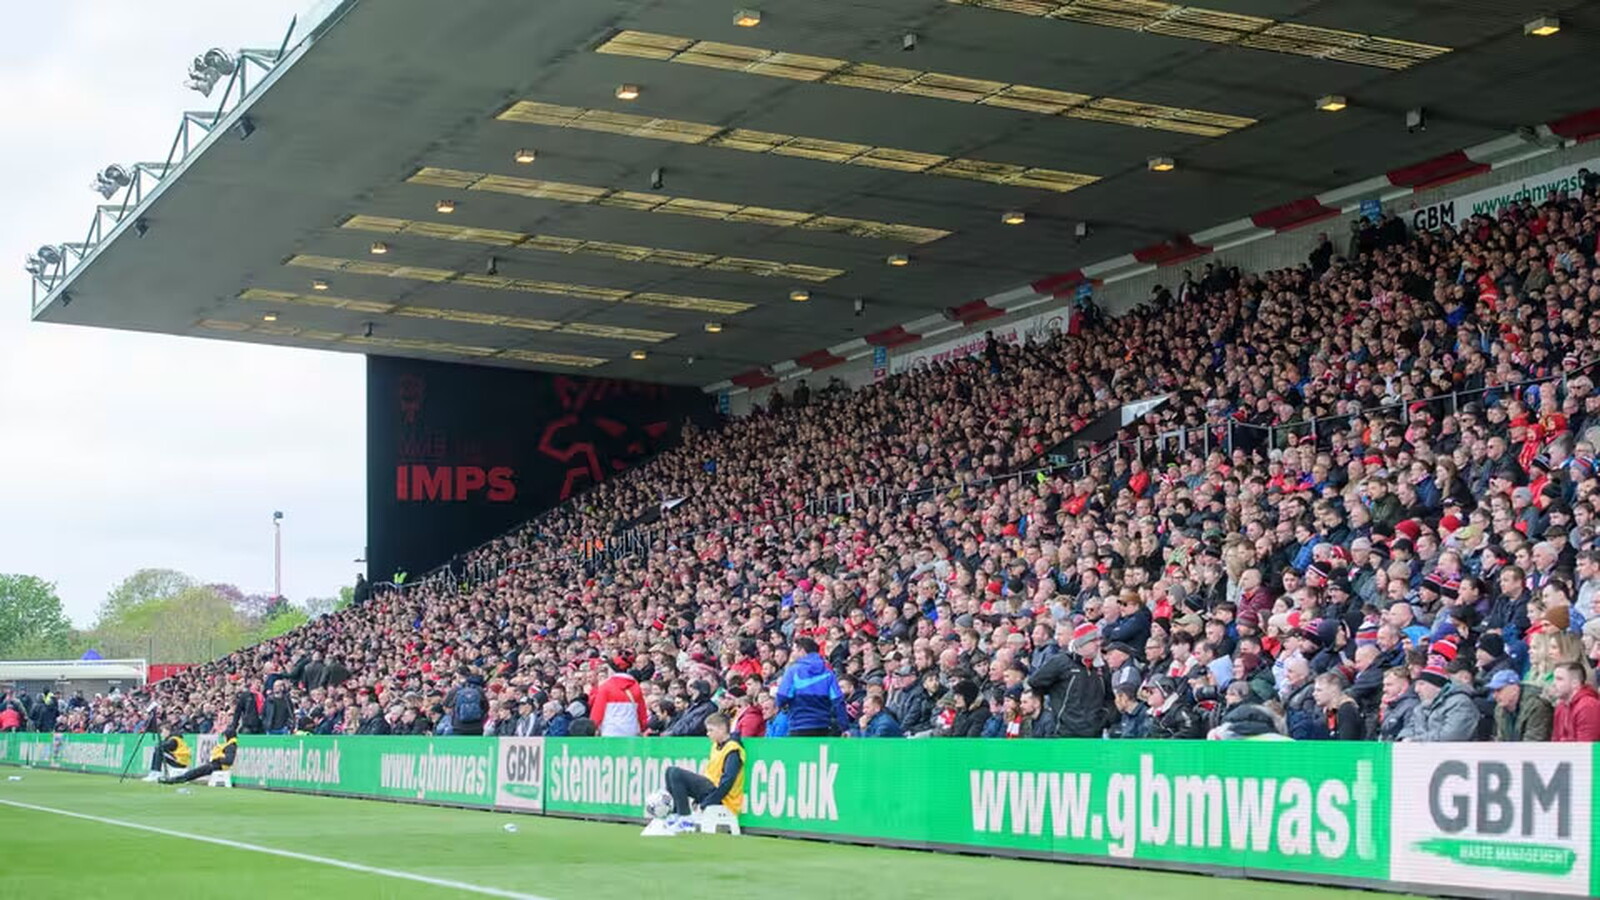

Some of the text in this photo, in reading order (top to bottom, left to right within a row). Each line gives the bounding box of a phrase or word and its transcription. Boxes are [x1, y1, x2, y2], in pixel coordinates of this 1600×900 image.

[1414, 201, 1454, 231] GBM
[397, 466, 516, 501] IMPS
[506, 745, 540, 782] GBM
[969, 754, 1378, 861] www.gbmwast
[1429, 760, 1573, 839] GBM
[1460, 844, 1568, 864] WASTE MANAGEMENT
